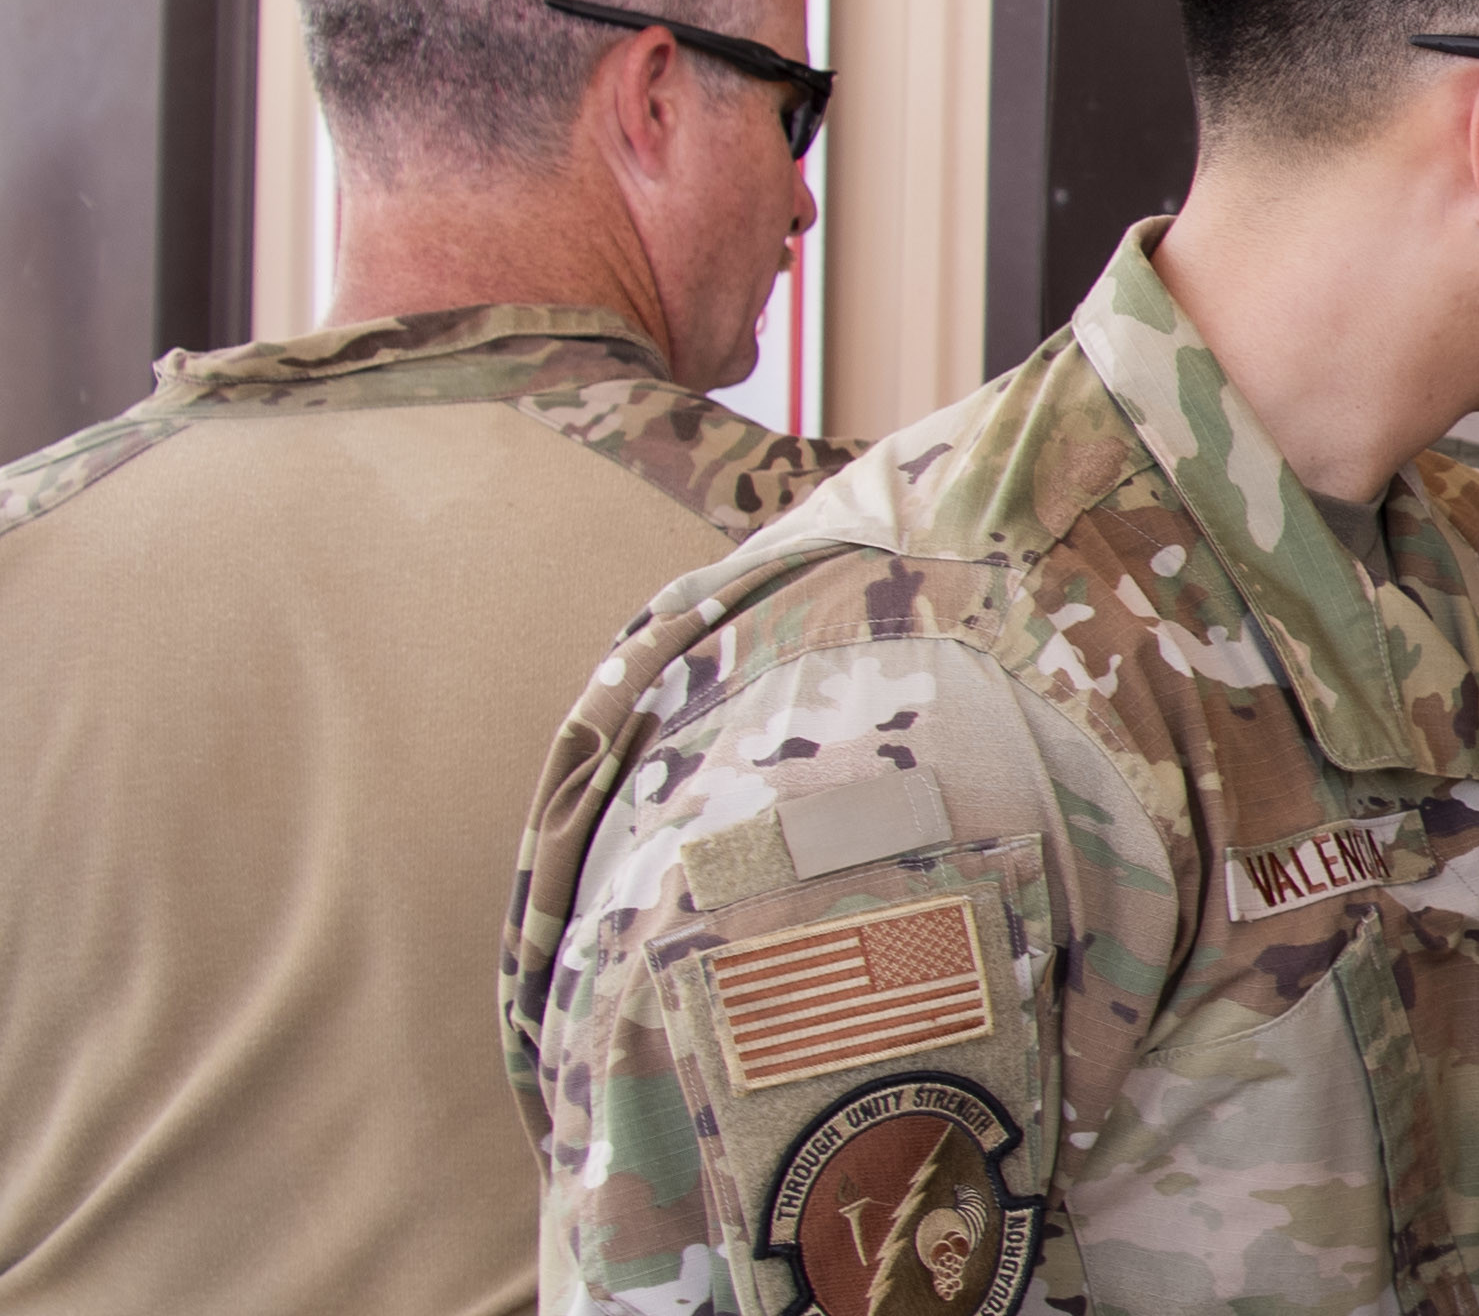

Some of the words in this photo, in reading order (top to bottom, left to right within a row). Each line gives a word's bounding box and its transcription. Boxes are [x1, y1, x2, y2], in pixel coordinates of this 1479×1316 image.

[777, 1128, 843, 1222] THROUGH
[845, 1089, 905, 1129] UNITY
[912, 1085, 995, 1139] STRENGTH
